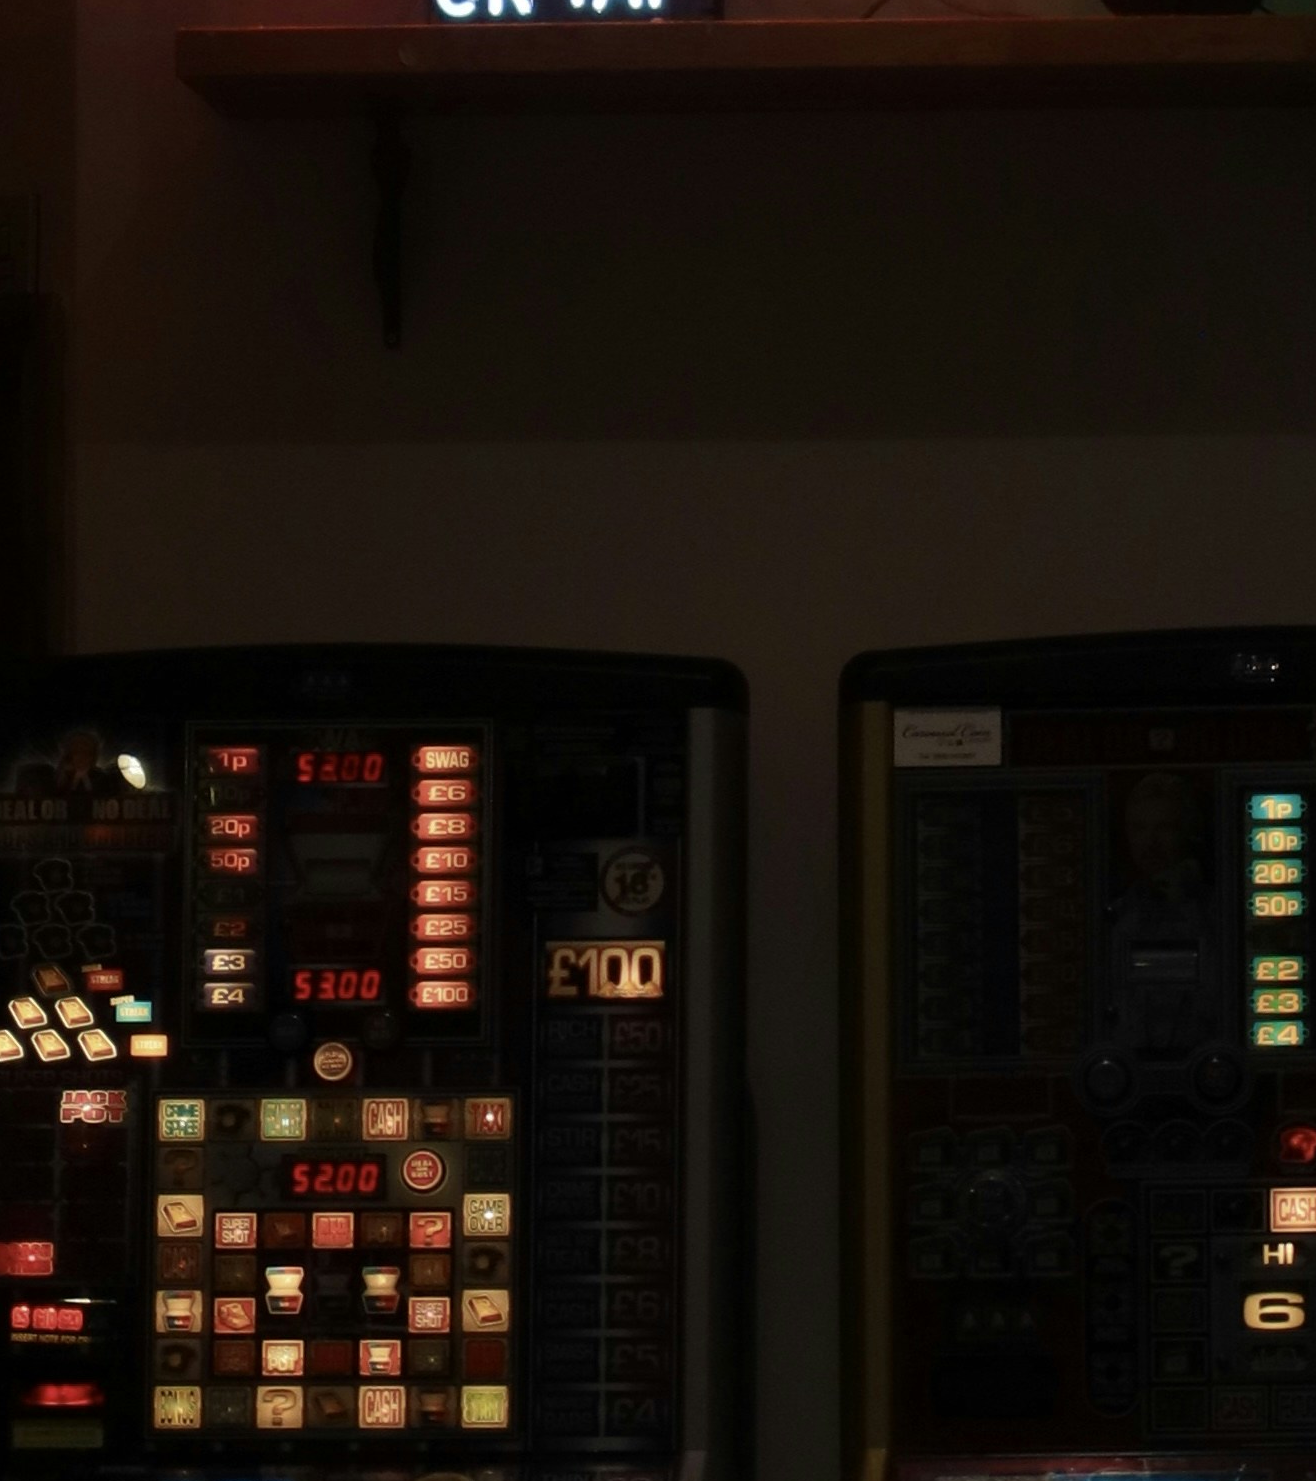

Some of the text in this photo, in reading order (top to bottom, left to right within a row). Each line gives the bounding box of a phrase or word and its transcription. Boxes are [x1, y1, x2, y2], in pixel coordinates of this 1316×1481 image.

[218, 753, 248, 771] 1p
[425, 751, 469, 769] SWAG
[428, 786, 466, 801] £6
[211, 820, 251, 838] 20p
[428, 819, 466, 835] £8
[210, 853, 250, 871] 50p
[425, 852, 468, 868] £10
[425, 886, 468, 902] £15
[213, 921, 246, 937] £2
[424, 920, 468, 936] £25
[211, 954, 246, 971] £3
[424, 953, 468, 969] £50
[548, 946, 665, 999] £100
[1255, 960, 1300, 981] £2
[211, 987, 246, 1004] £4
[421, 986, 469, 1003] £100
[1256, 992, 1300, 1014] £3
[1256, 1025, 1300, 1046] £4
[61, 1090, 127, 1105] JACK
[60, 1105, 125, 1123] POT
[366, 1101, 404, 1137] CASH
[468, 1198, 505, 1216] GAME
[221, 1217, 250, 1230] SUPER
[468, 1216, 505, 1232] OVER
[221, 1229, 249, 1244] SHOT
[1262, 1242, 1294, 1265] HI
[414, 1303, 443, 1315] SUPER
[1243, 1292, 1306, 1330] 6
[414, 1315, 443, 1330] SHOT
[363, 1389, 400, 1425] CASH
